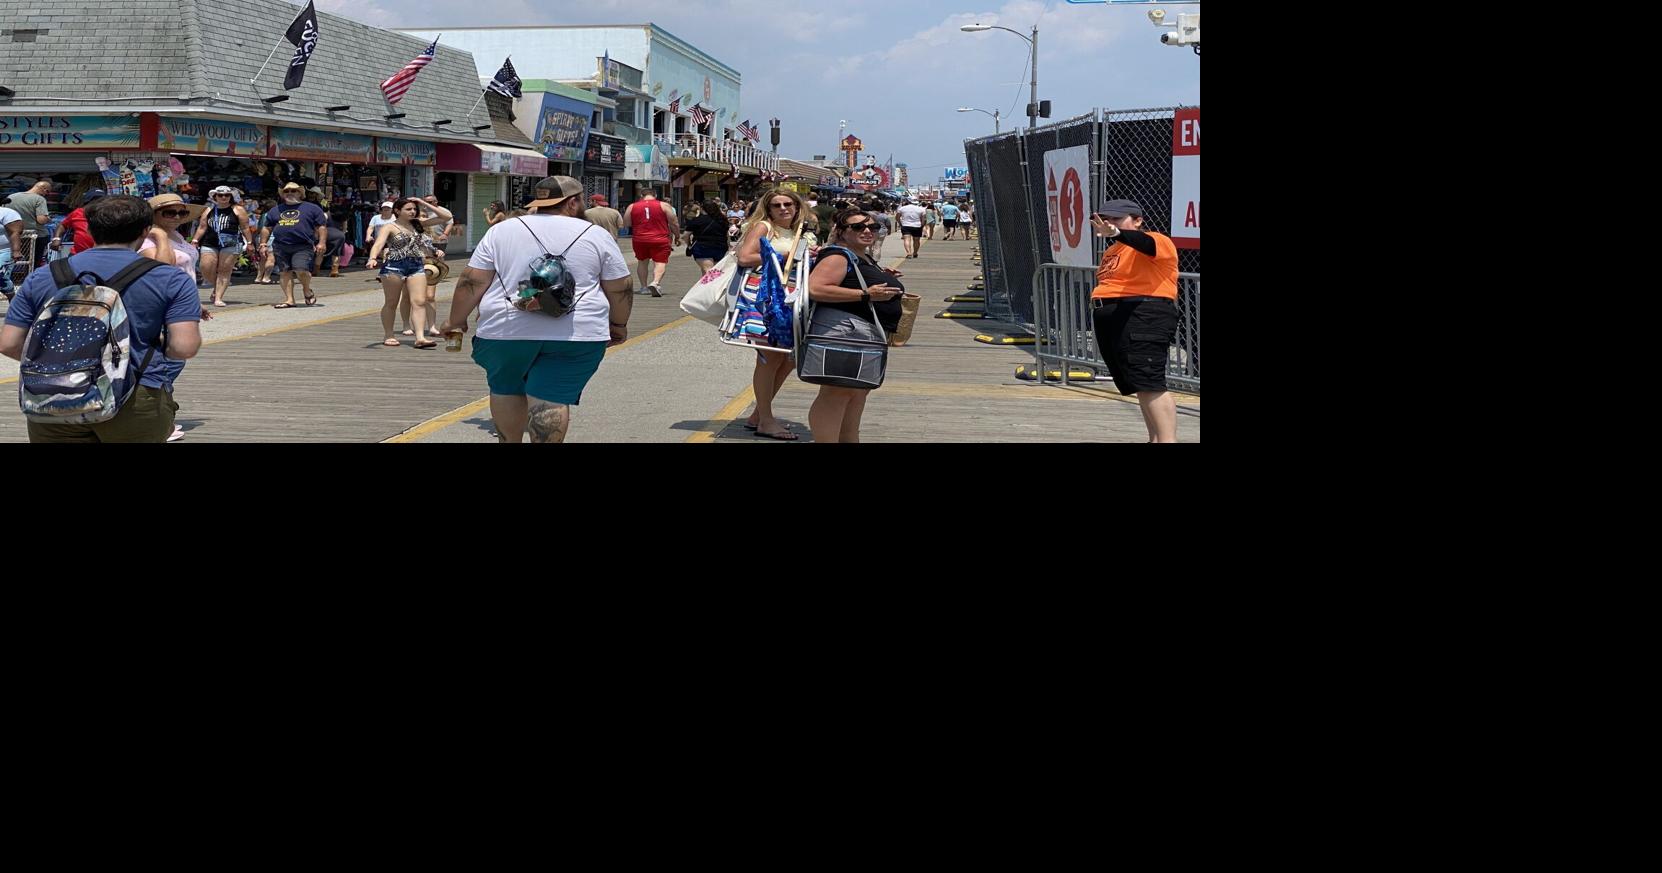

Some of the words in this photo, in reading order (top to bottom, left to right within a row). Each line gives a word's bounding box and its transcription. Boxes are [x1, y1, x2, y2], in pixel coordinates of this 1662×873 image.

[0, 115, 71, 129] STYLES
[21, 131, 84, 146] GIFTS
[233, 127, 260, 143] GIFTS
[644, 207, 650, 220] 1
[1067, 180, 1075, 236] 3
